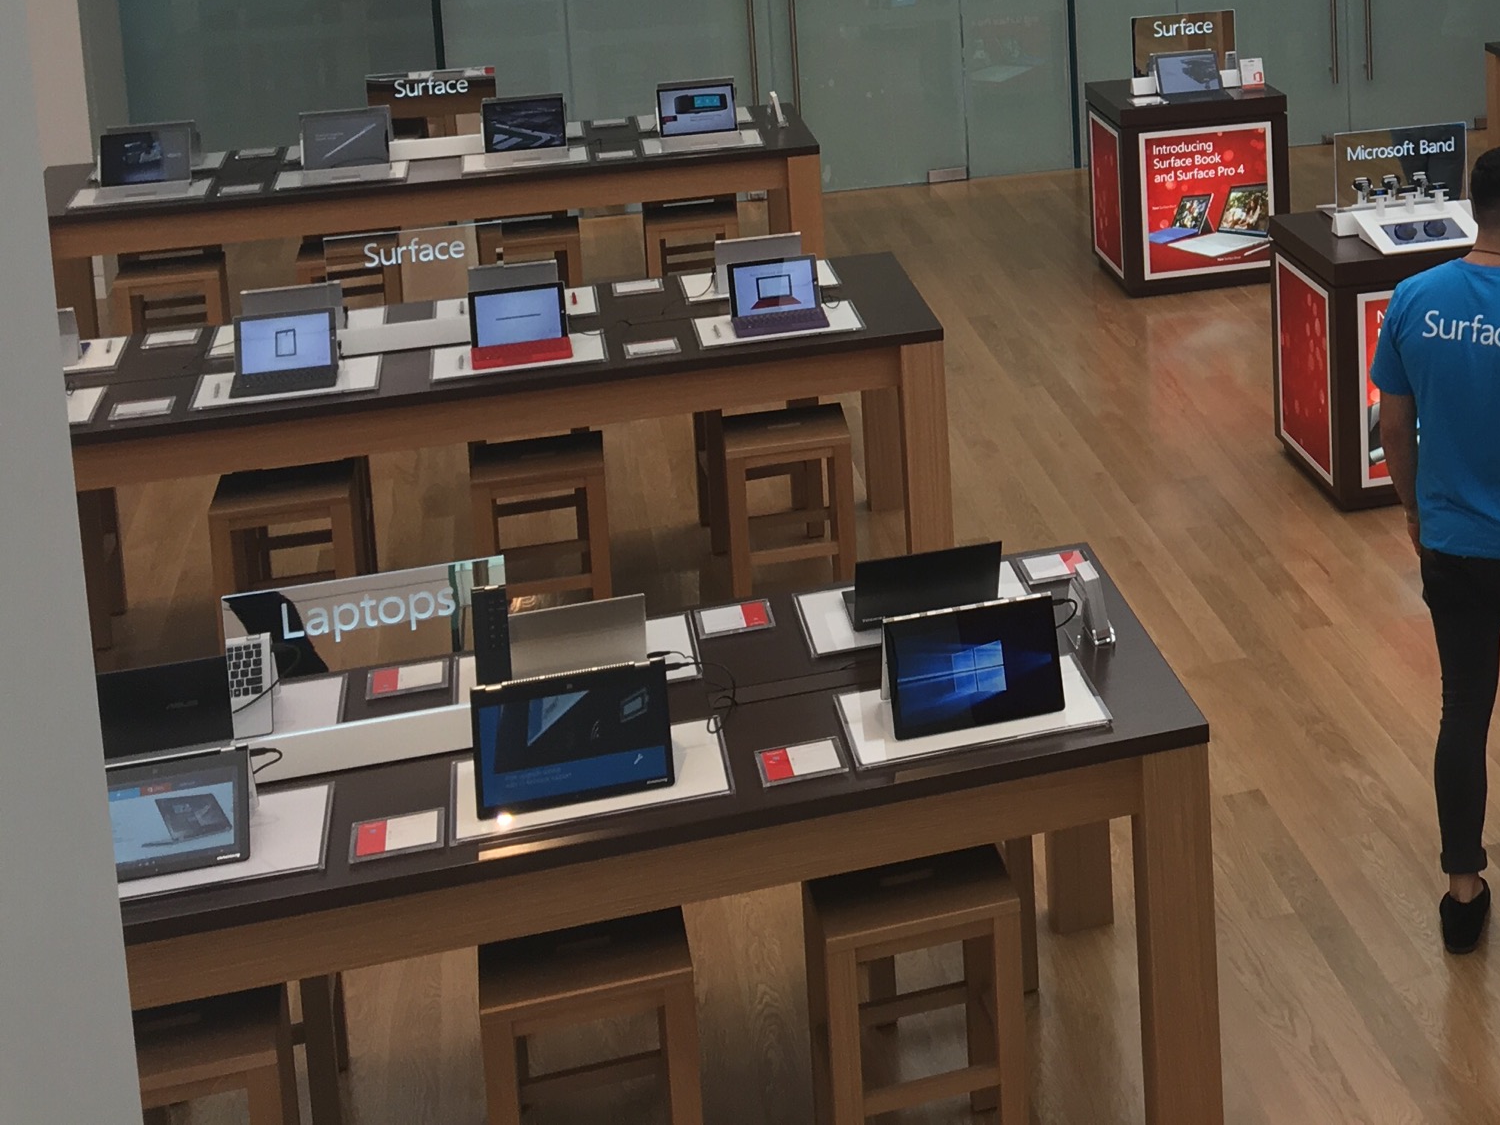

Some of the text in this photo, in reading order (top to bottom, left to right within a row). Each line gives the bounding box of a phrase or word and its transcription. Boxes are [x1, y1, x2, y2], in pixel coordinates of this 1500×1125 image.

[1153, 18, 1213, 38] Surface
[394, 76, 469, 98] Surface
[1152, 140, 1213, 155] Introducing
[1346, 136, 1455, 162] Microsoft Band
[1153, 152, 1222, 170] Surface Book
[1154, 164, 1245, 183] and Surface Pro 4
[363, 237, 465, 268] Surface
[280, 585, 456, 643] Laptops
